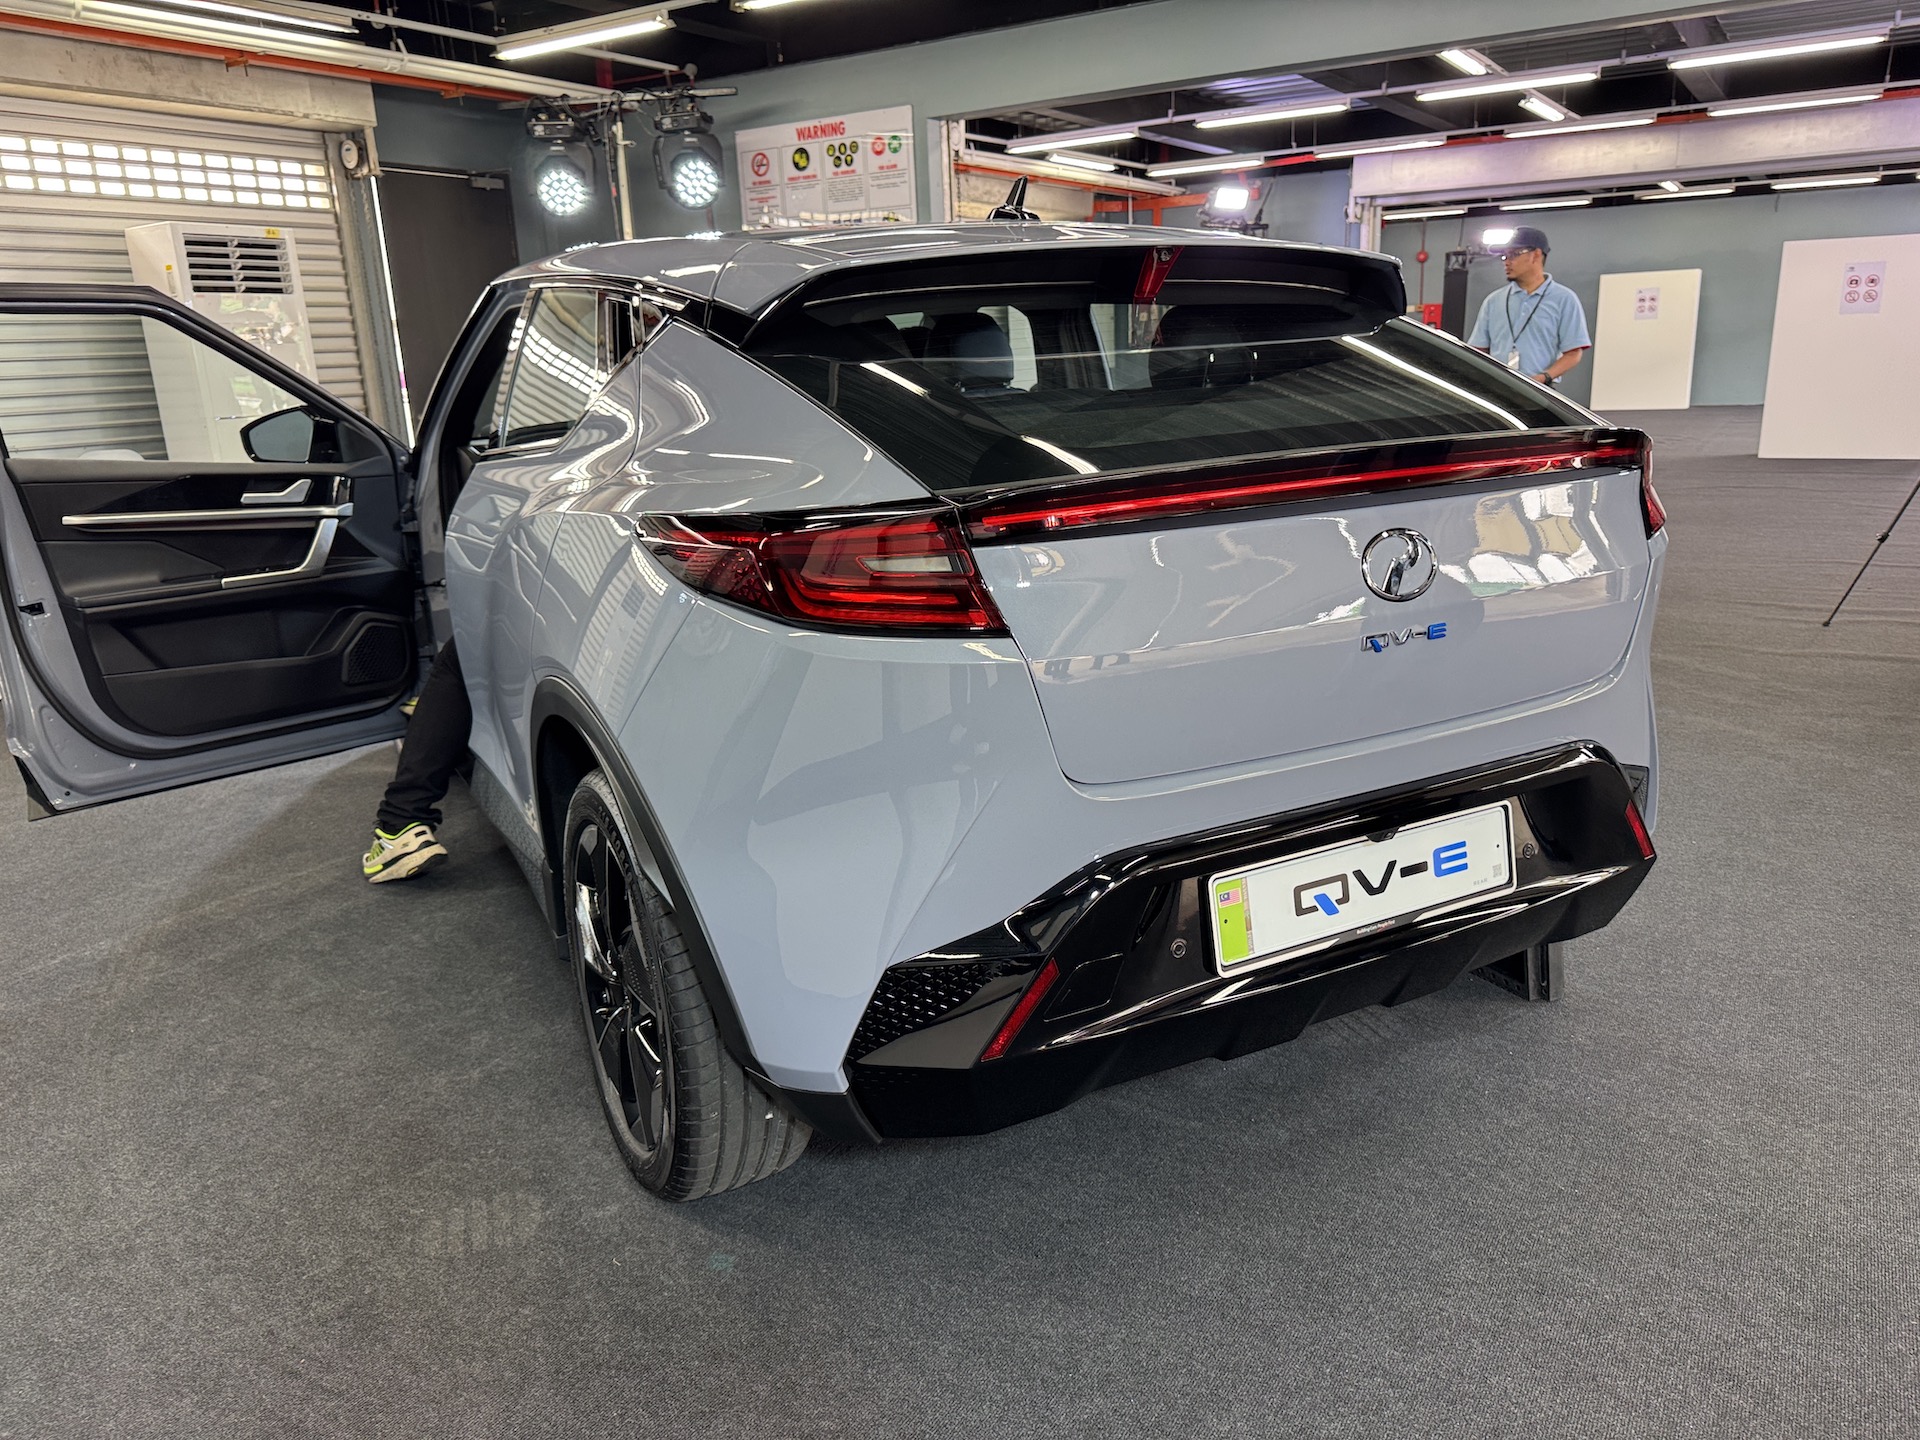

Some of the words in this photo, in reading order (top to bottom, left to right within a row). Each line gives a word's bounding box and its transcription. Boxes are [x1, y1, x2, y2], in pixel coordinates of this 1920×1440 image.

[796, 122, 845, 141] WARNING
[1360, 622, 1447, 653] QV-E
[1294, 841, 1468, 916] QV-E
